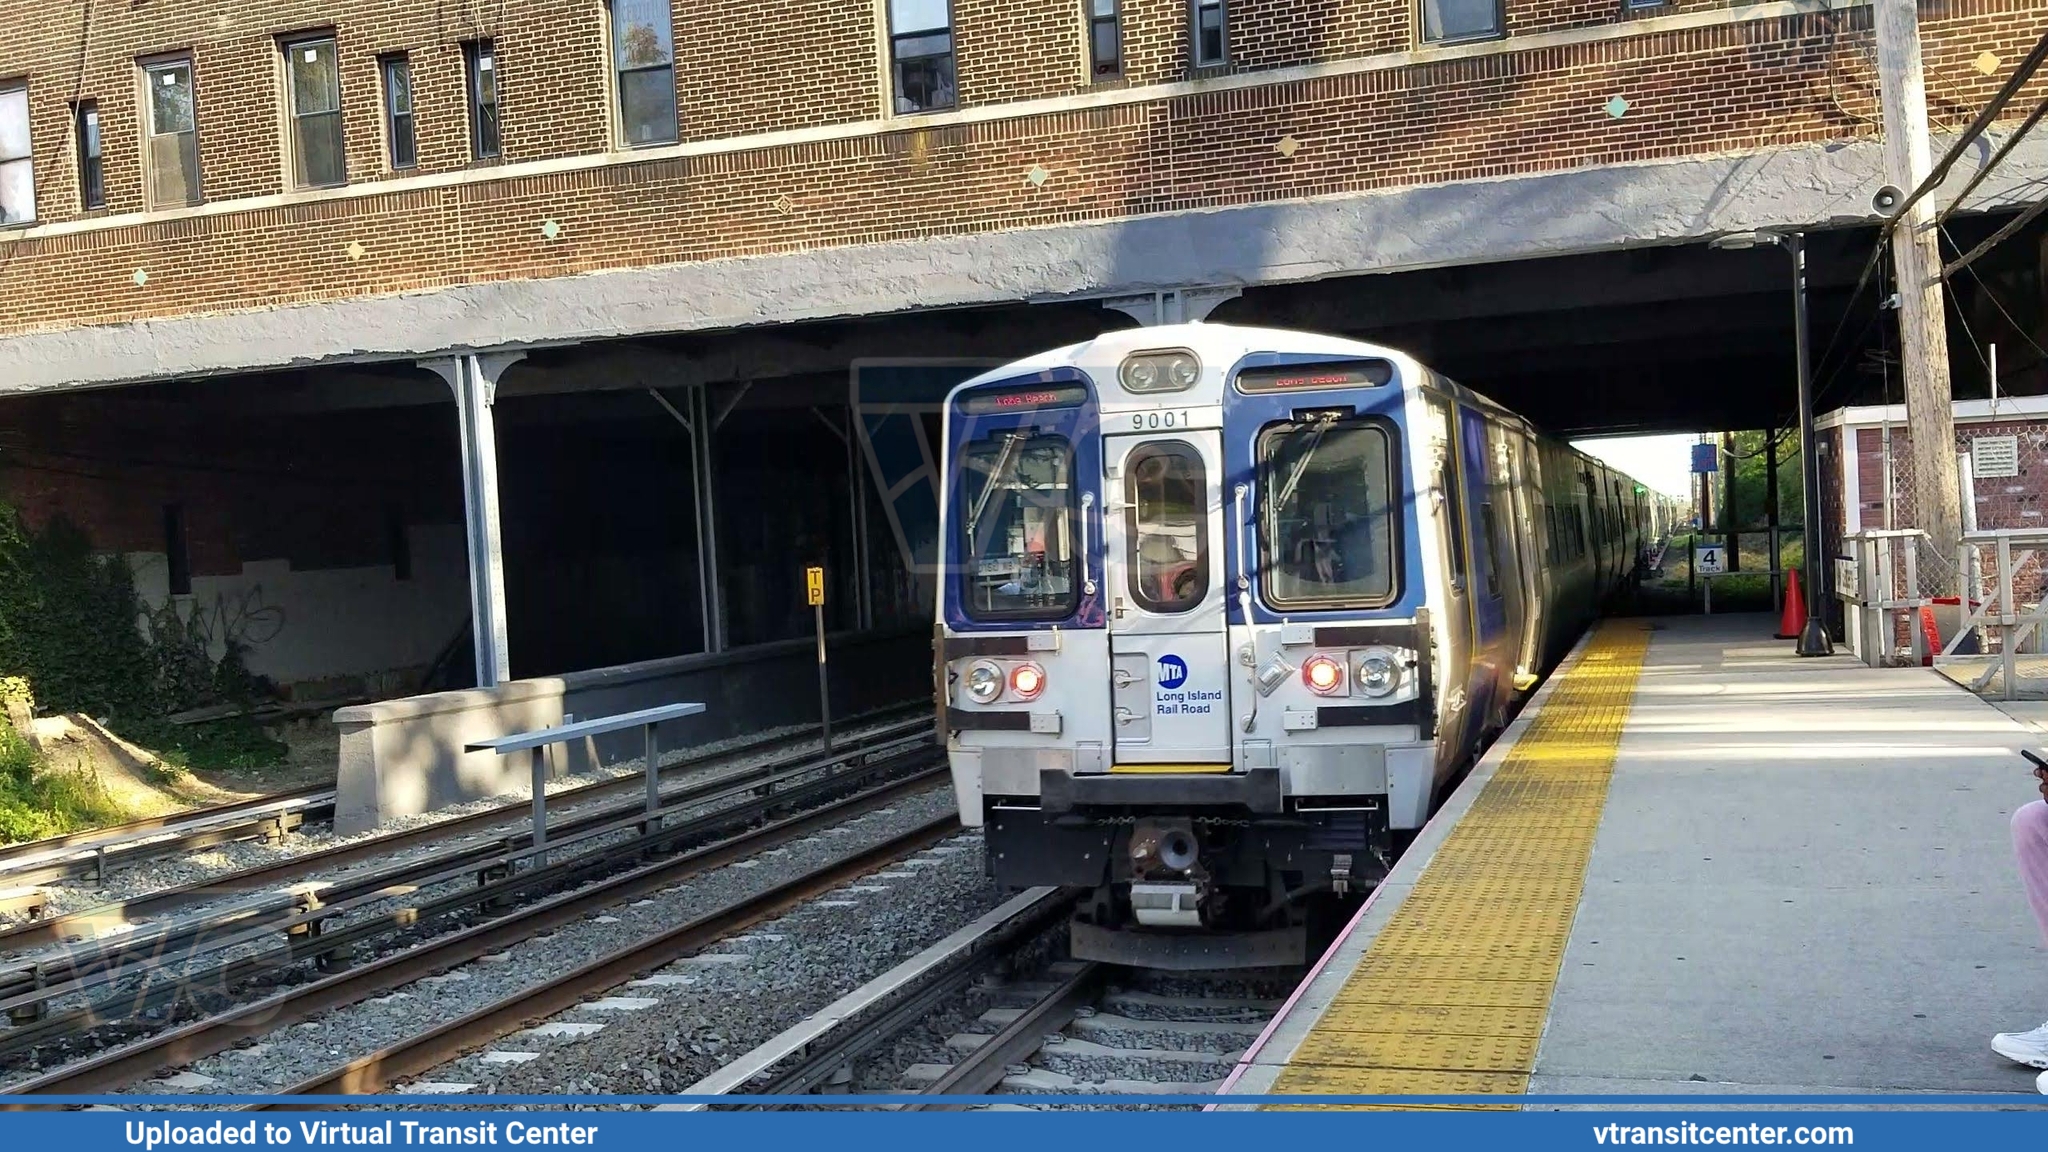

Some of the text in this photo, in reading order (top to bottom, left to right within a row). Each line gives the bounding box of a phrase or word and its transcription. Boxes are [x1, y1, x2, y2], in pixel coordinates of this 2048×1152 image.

[1132, 410, 1188, 430] 9001
[1703, 549, 1717, 565] 4
[1156, 690, 1222, 703] Long Island
[1157, 703, 1211, 714] Rail Road
